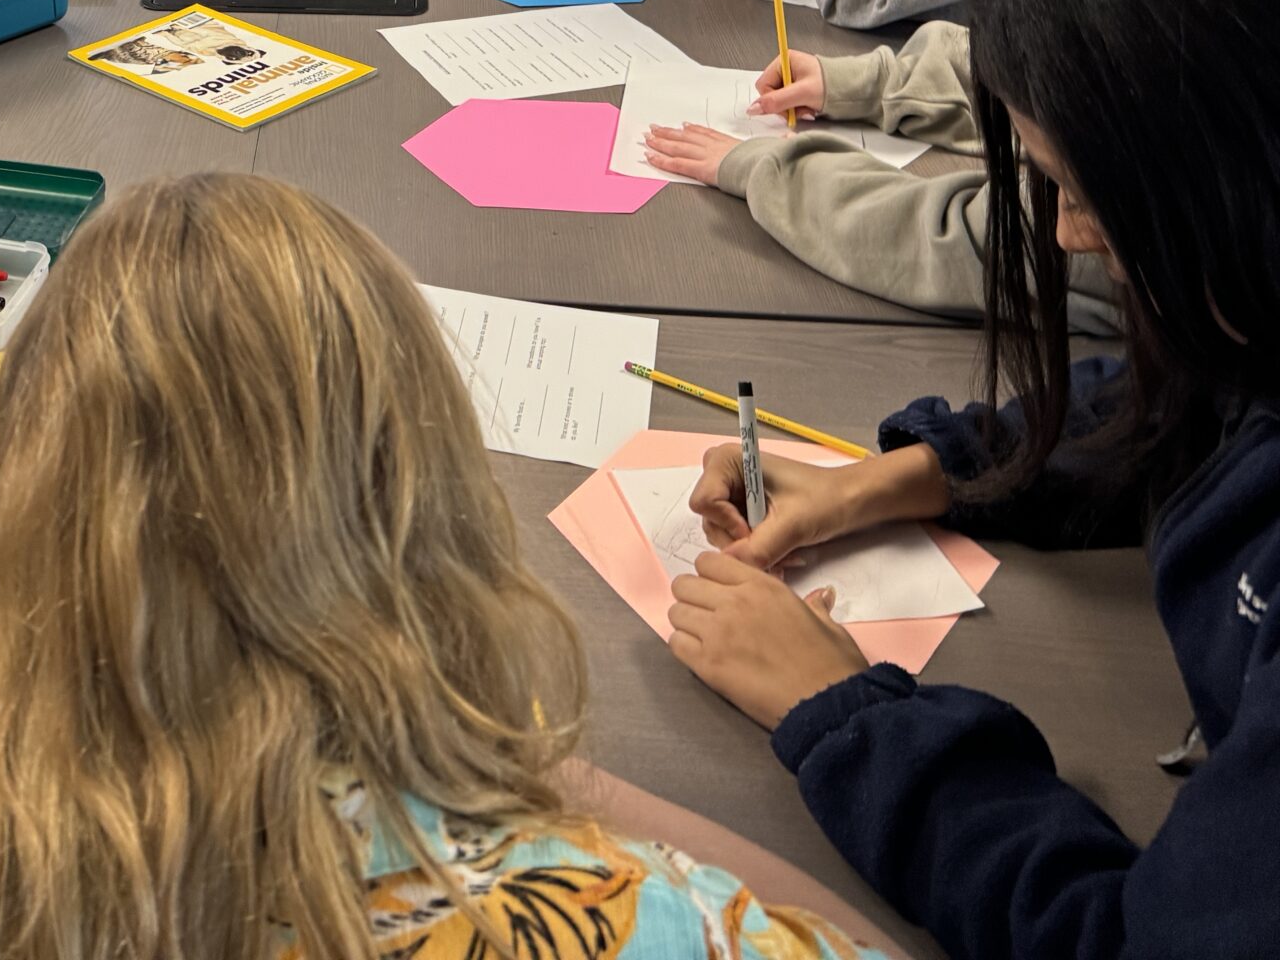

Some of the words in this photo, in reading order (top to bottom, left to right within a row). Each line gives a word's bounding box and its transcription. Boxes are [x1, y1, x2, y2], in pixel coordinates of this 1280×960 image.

[188, 60, 270, 97] minds
[233, 54, 312, 95] animal
[297, 60, 328, 74] Inside
